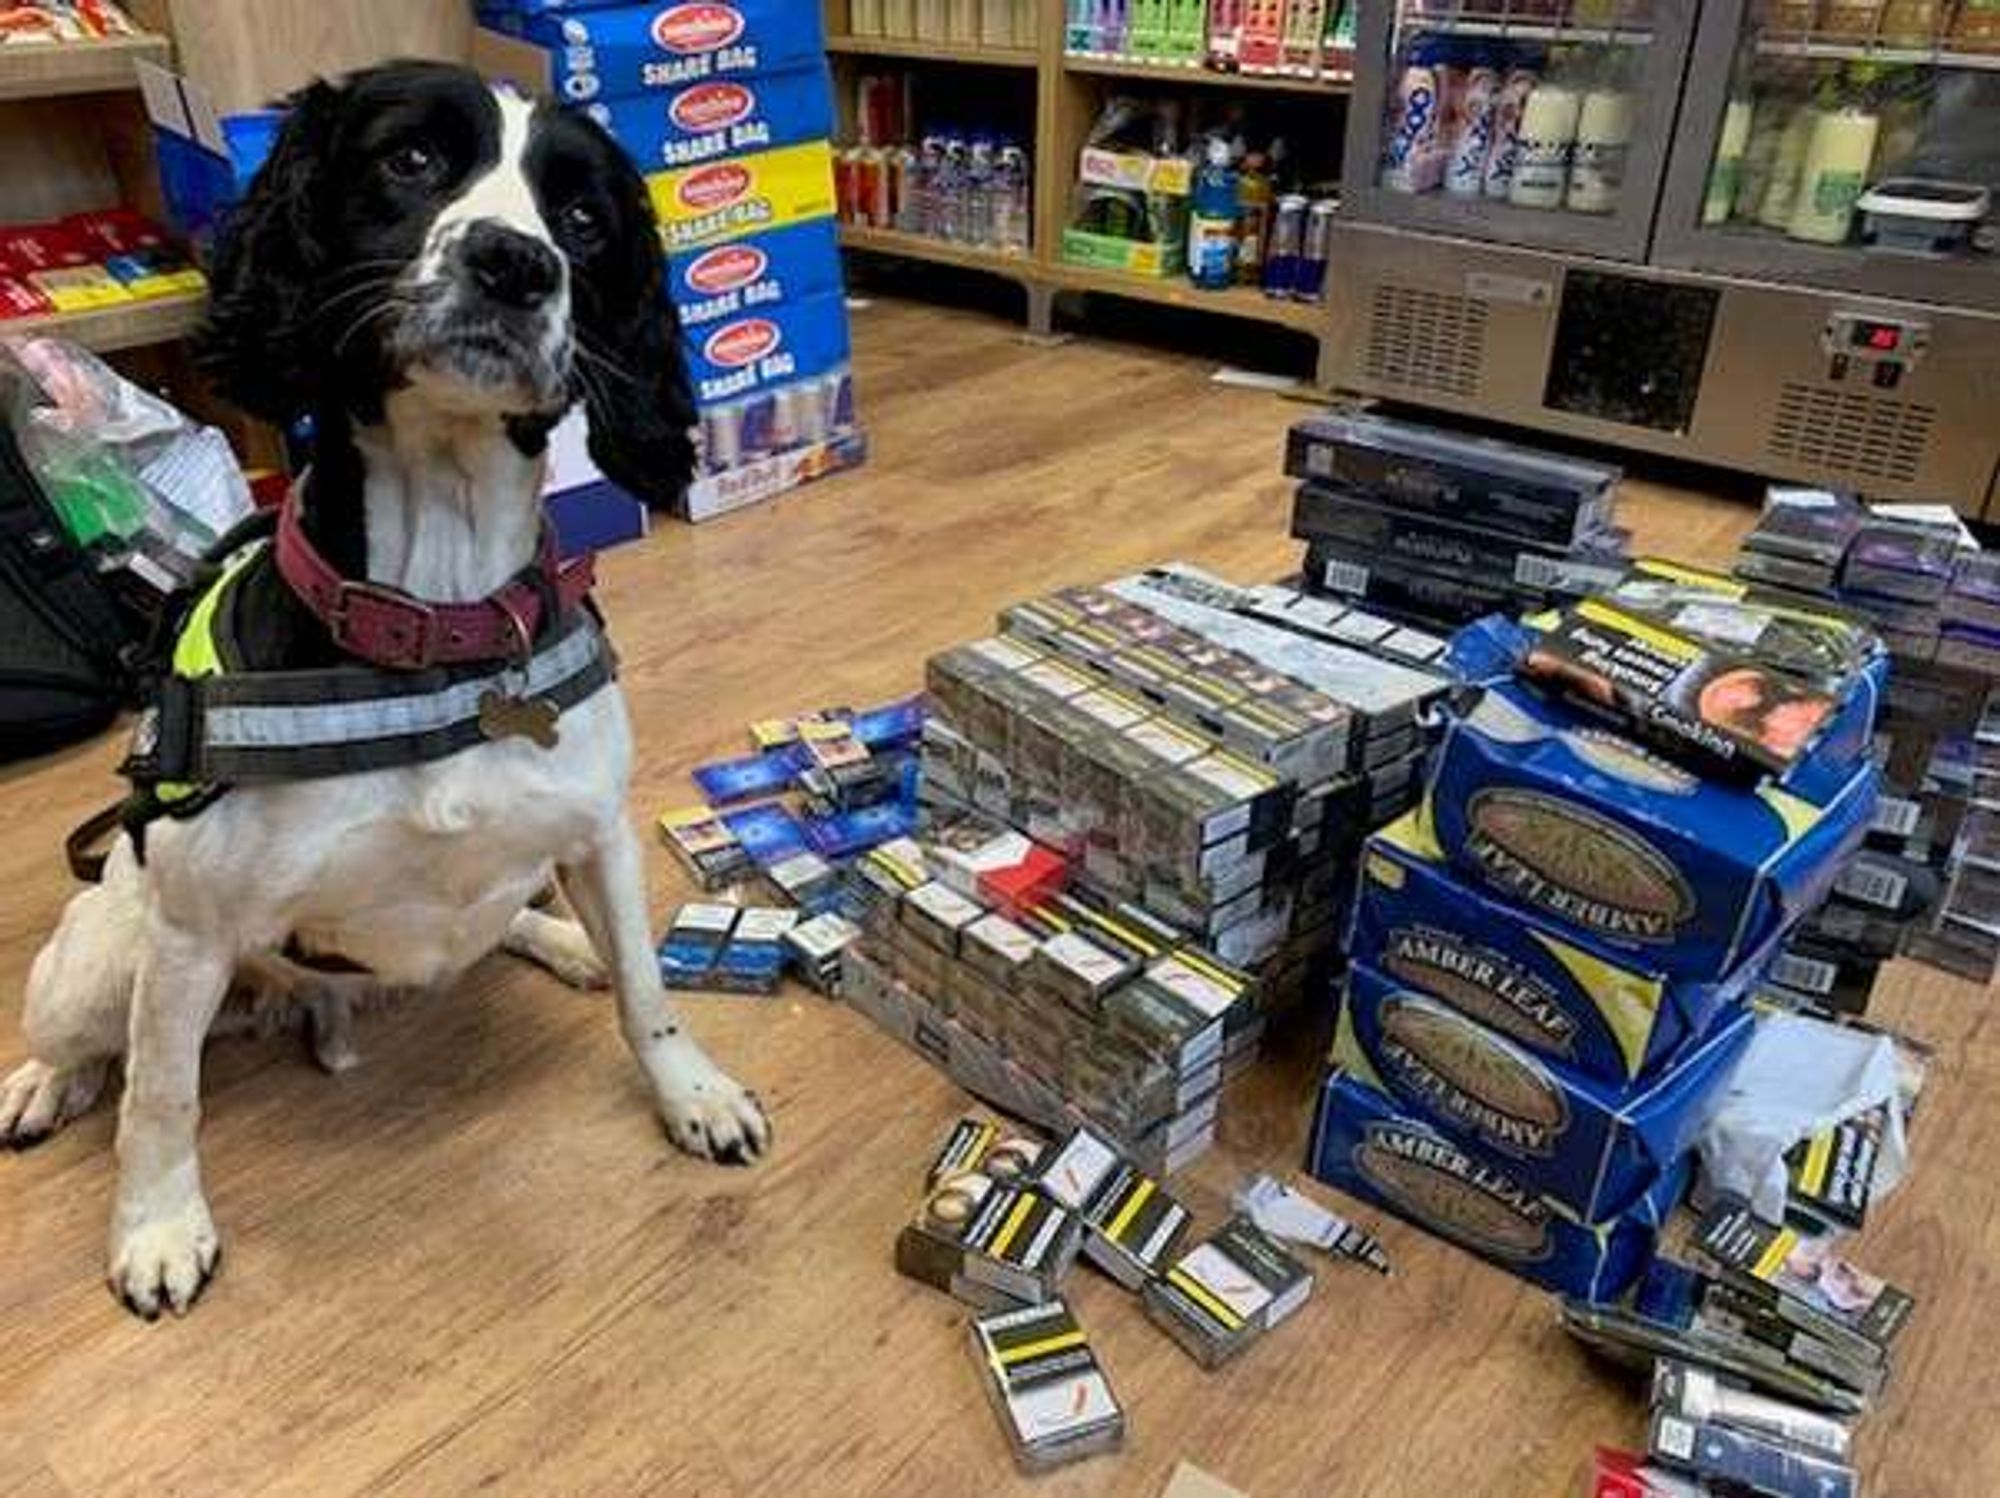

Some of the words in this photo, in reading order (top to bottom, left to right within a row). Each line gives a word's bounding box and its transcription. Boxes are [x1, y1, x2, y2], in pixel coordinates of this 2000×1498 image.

[643, 55, 711, 85] SHARE
[716, 45, 758, 70] BAG
[664, 132, 727, 164] SHARE
[731, 121, 770, 147] BAG
[678, 292, 740, 325] SHARE
[744, 279, 782, 305] BAG
[701, 364, 758, 400] SHARE
[761, 352, 796, 379] BAG
[1548, 886, 1666, 935] AMBER
[1397, 936, 1495, 986] AMBER
[1496, 974, 1572, 1031] LEAF
[1374, 1128, 1471, 1178] AMBER
[1473, 1167, 1549, 1218] LEAF
